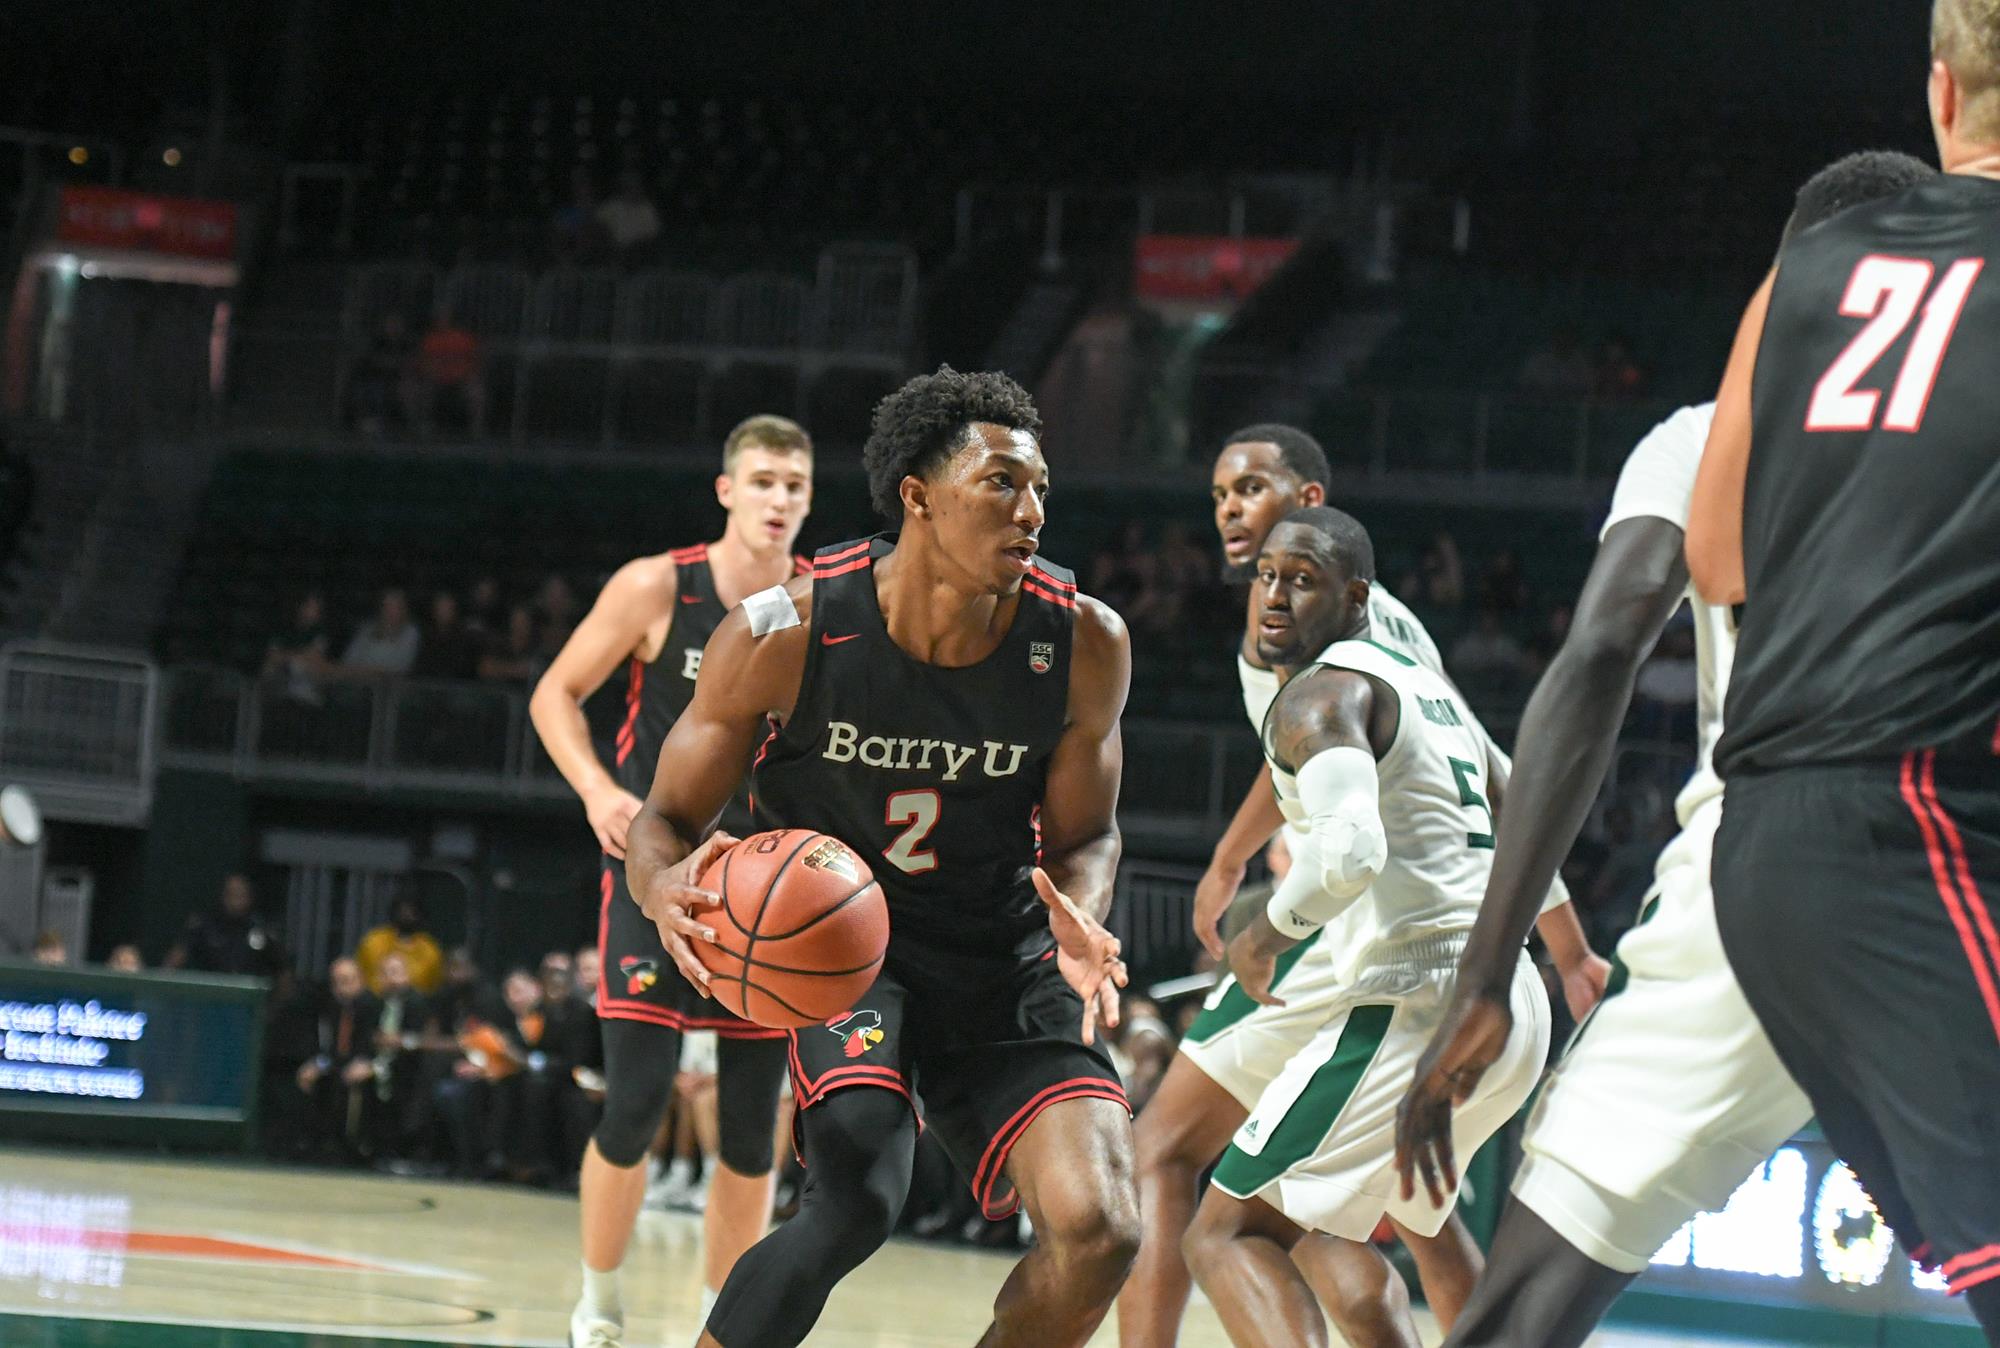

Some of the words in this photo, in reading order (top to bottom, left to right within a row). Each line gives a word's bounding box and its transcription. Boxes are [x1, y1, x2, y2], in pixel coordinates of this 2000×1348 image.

[1804, 253, 1985, 433] 21
[822, 721, 976, 781] Barry
[983, 740, 1028, 777] U
[882, 788, 941, 875] 2
[1447, 755, 1496, 849] 5
